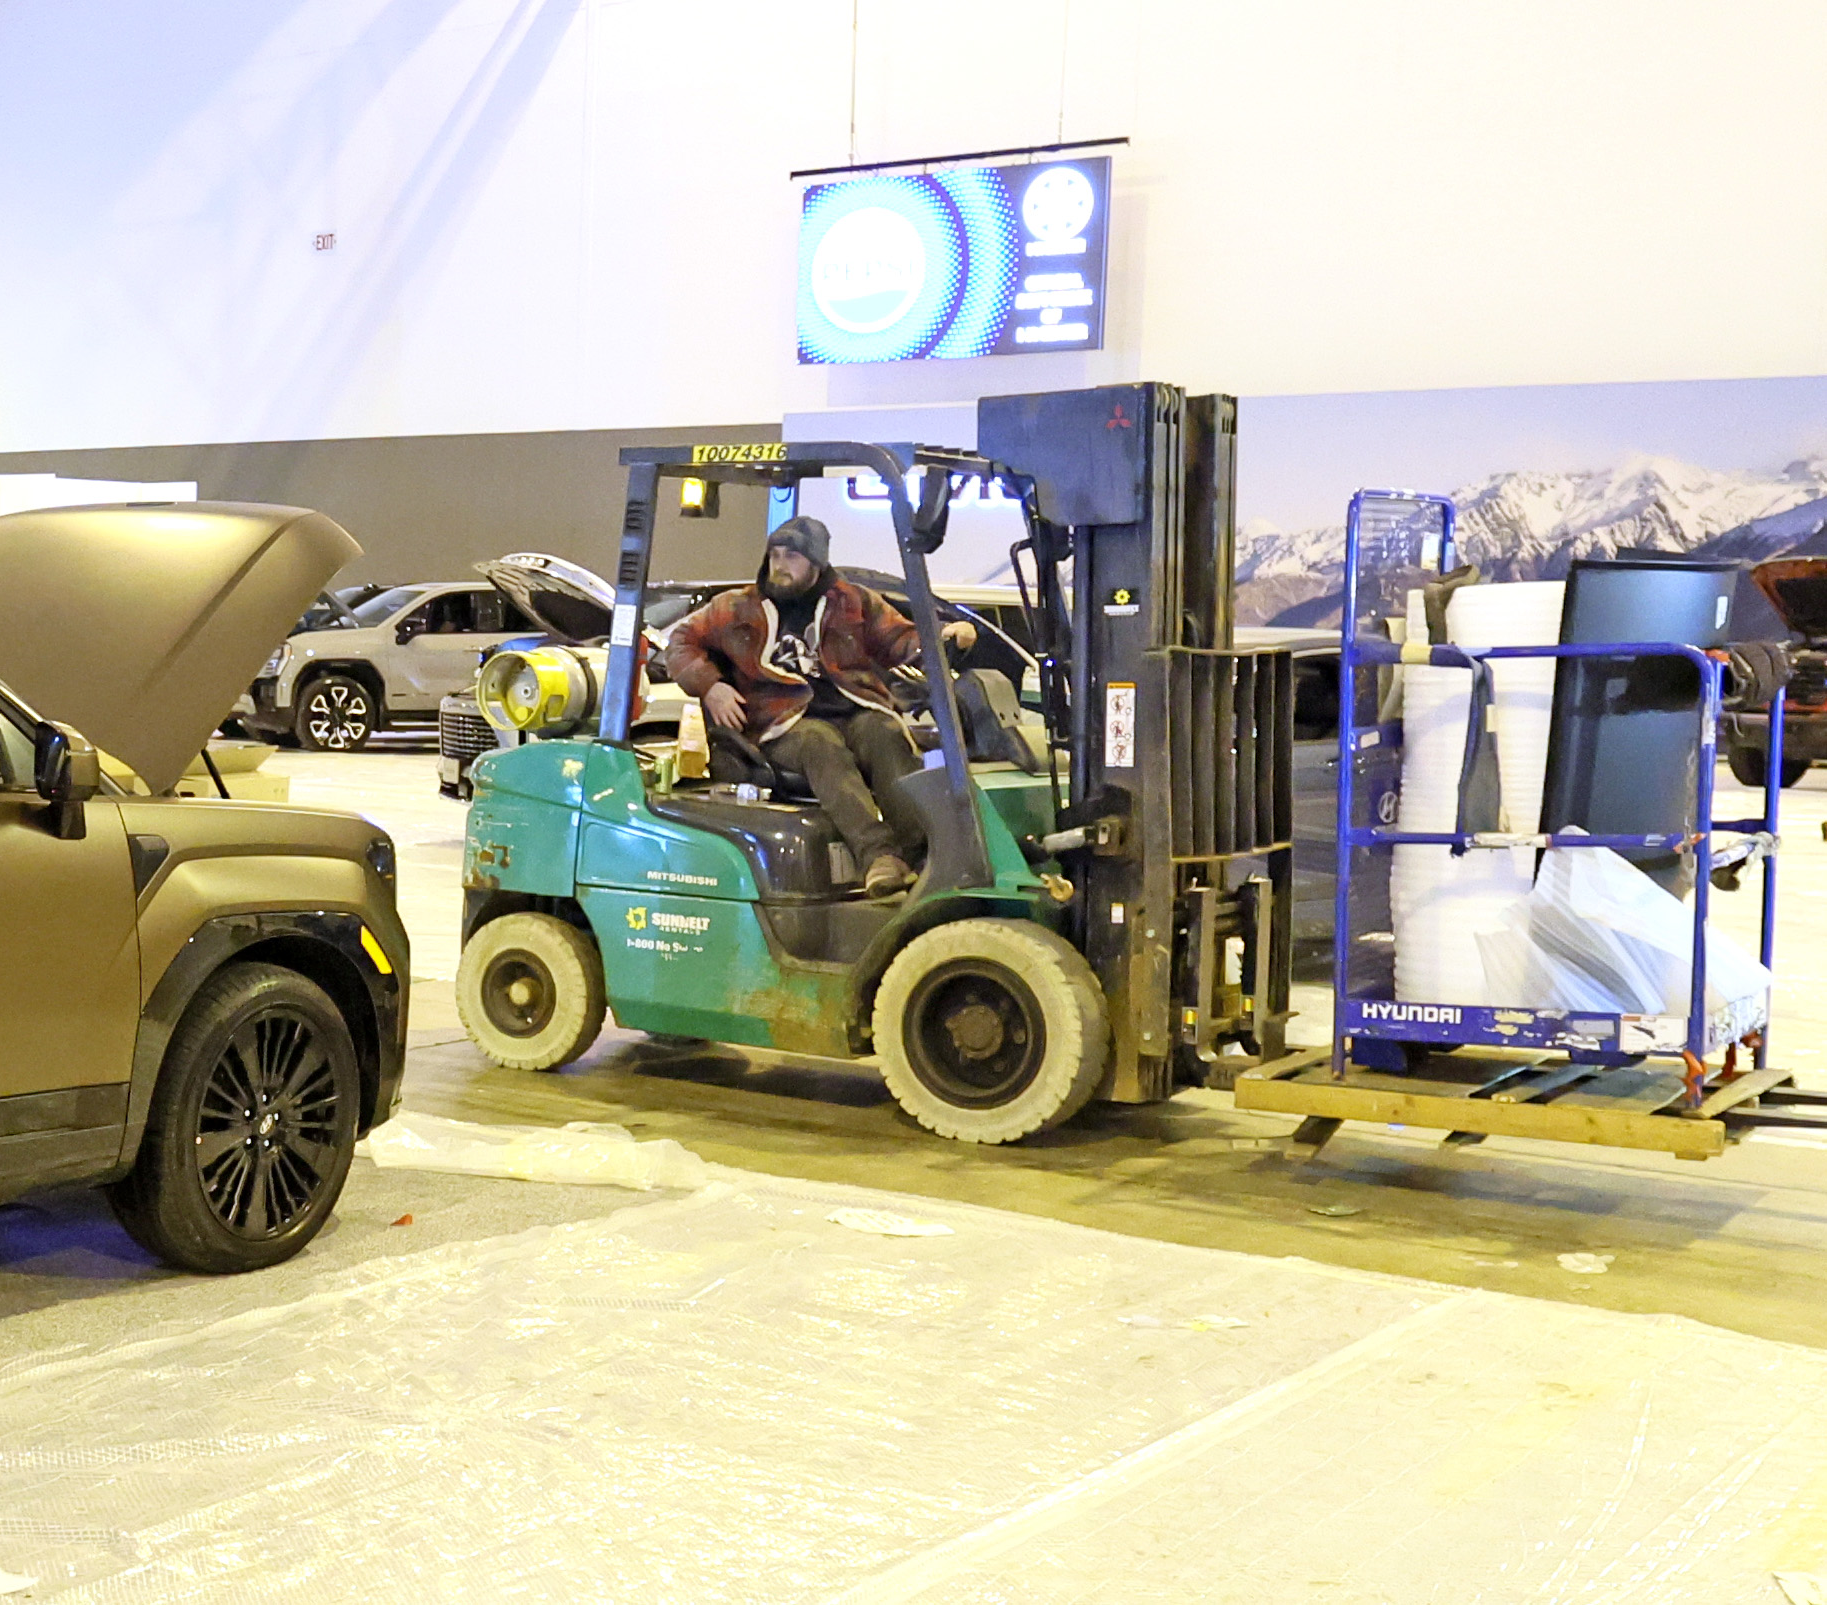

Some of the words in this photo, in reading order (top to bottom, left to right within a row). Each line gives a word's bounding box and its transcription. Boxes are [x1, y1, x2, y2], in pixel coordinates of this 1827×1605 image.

[697, 444, 787, 462] 10074316
[647, 870, 718, 886] MITSUBISHI
[1362, 1002, 1462, 1025] HYUNDAI
